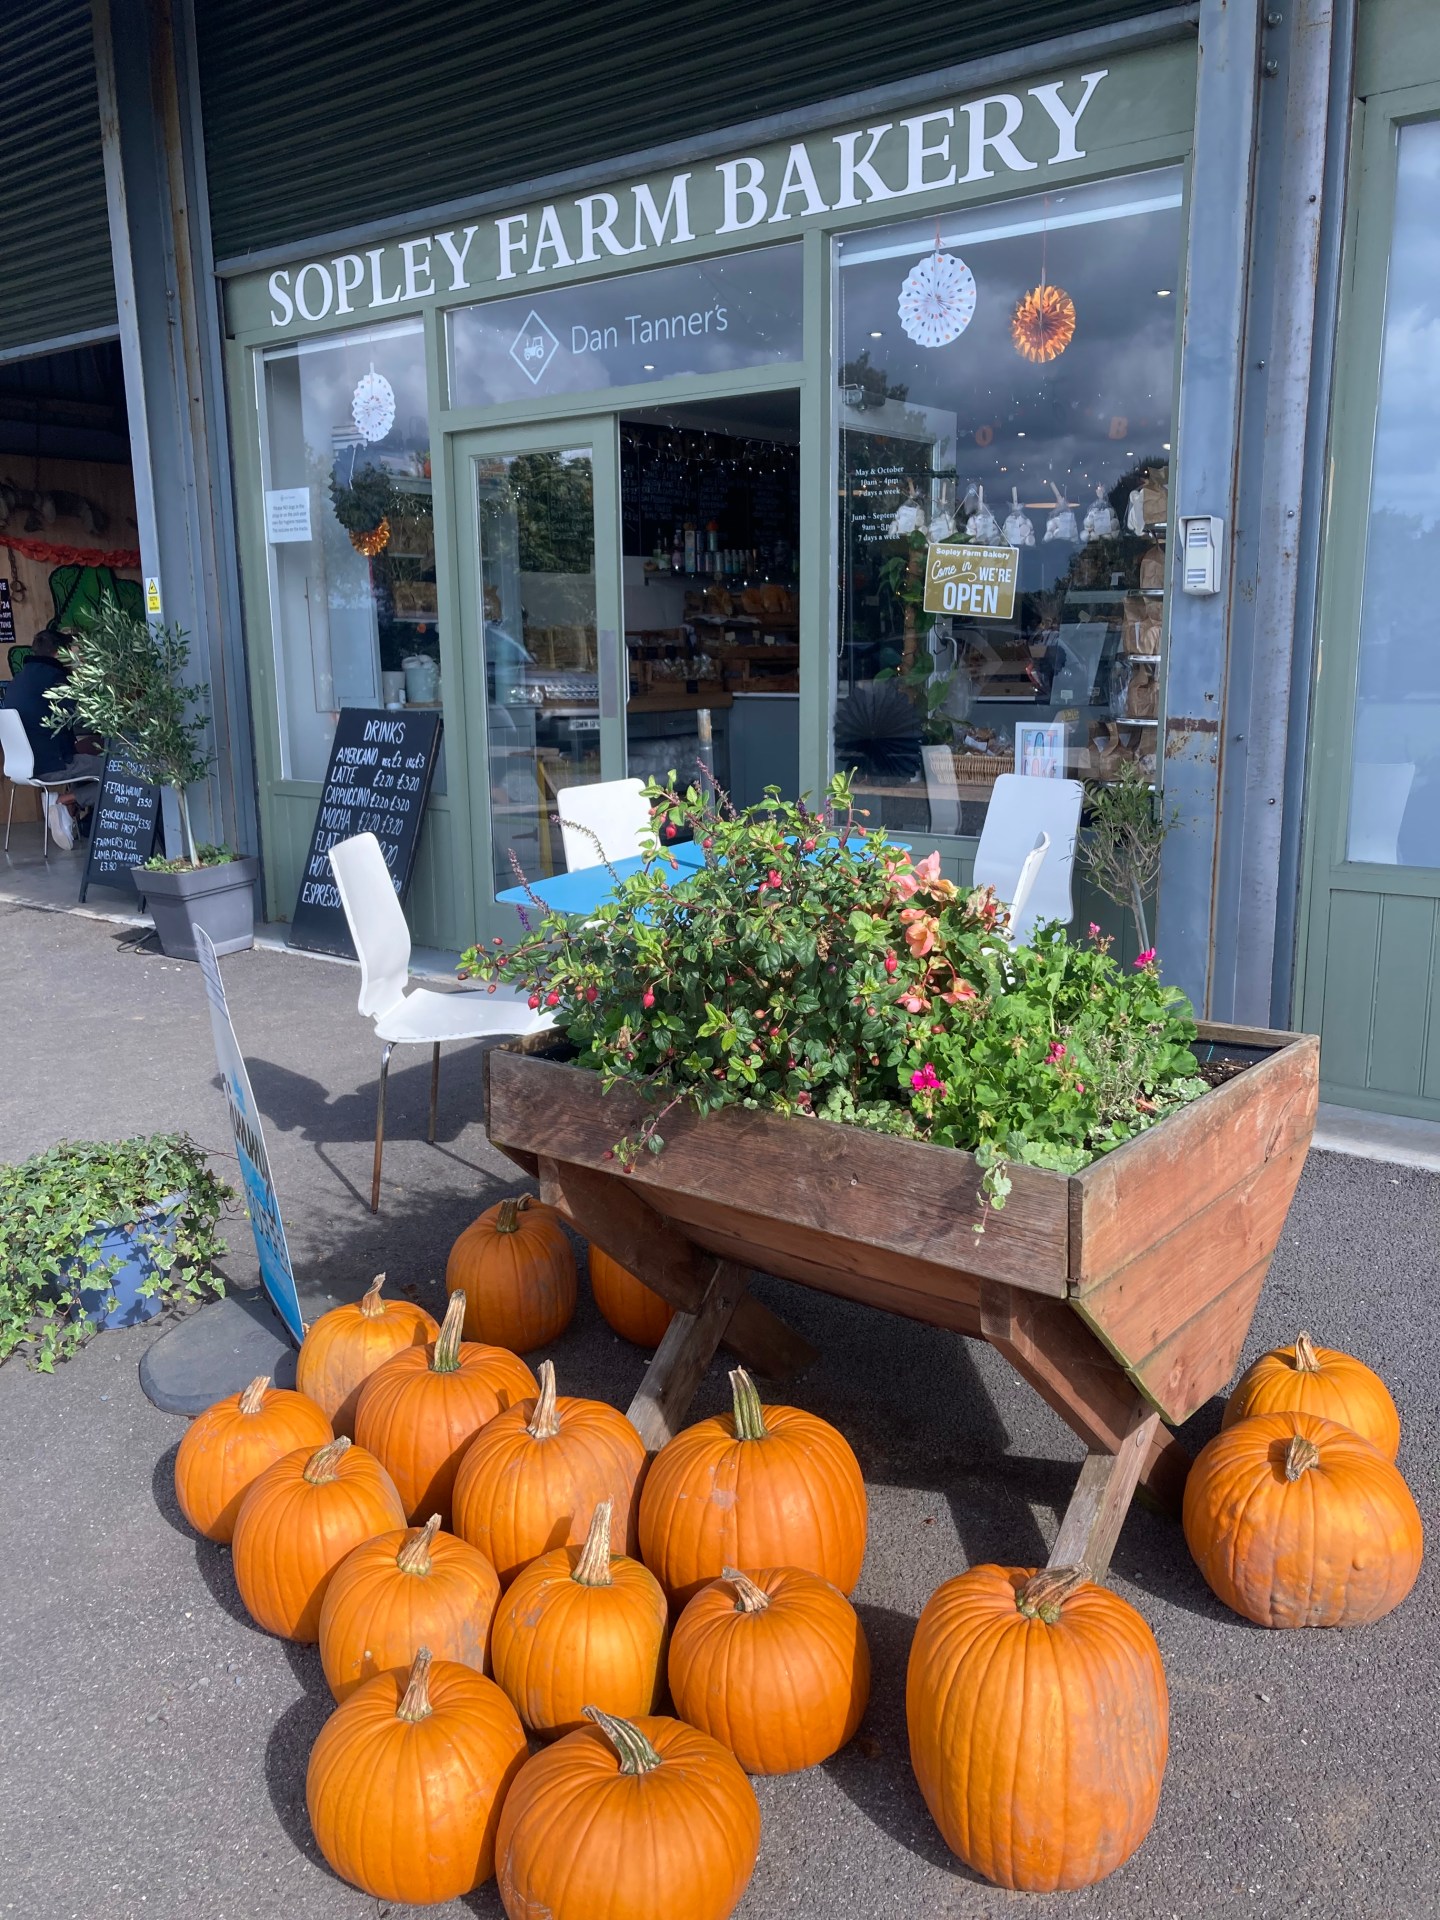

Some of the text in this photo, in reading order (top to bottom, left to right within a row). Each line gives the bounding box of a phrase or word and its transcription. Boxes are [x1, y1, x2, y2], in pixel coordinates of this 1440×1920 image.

[268, 70, 1108, 327] SOPLEY FARM BAKERY
[572, 305, 728, 354] Dan Tanner's
[855, 469, 869, 477] May
[877, 466, 904, 474] October
[884, 477, 899, 486] 4pm
[864, 489, 877, 498] days
[851, 514, 866, 522] June
[863, 534, 877, 542] days
[936, 547, 1010, 560] Sopley Farm Bakery
[931, 560, 972, 580] Come in
[979, 566, 1012, 583] WE'RE
[943, 582, 999, 614] OPEN
[363, 720, 406, 744] DRINKS
[1024, 730, 1058, 757] EAT
[336, 747, 378, 766] AMERICANO
[331, 766, 358, 784] LATTE
[325, 785, 371, 808] CAPPUCCINO
[100, 819, 138, 836] POTATO PASTY
[320, 807, 351, 831] MOCHA
[124, 838, 137, 850] ROLL
[315, 830, 340, 852] FLAT
[309, 854, 328, 877] HOT
